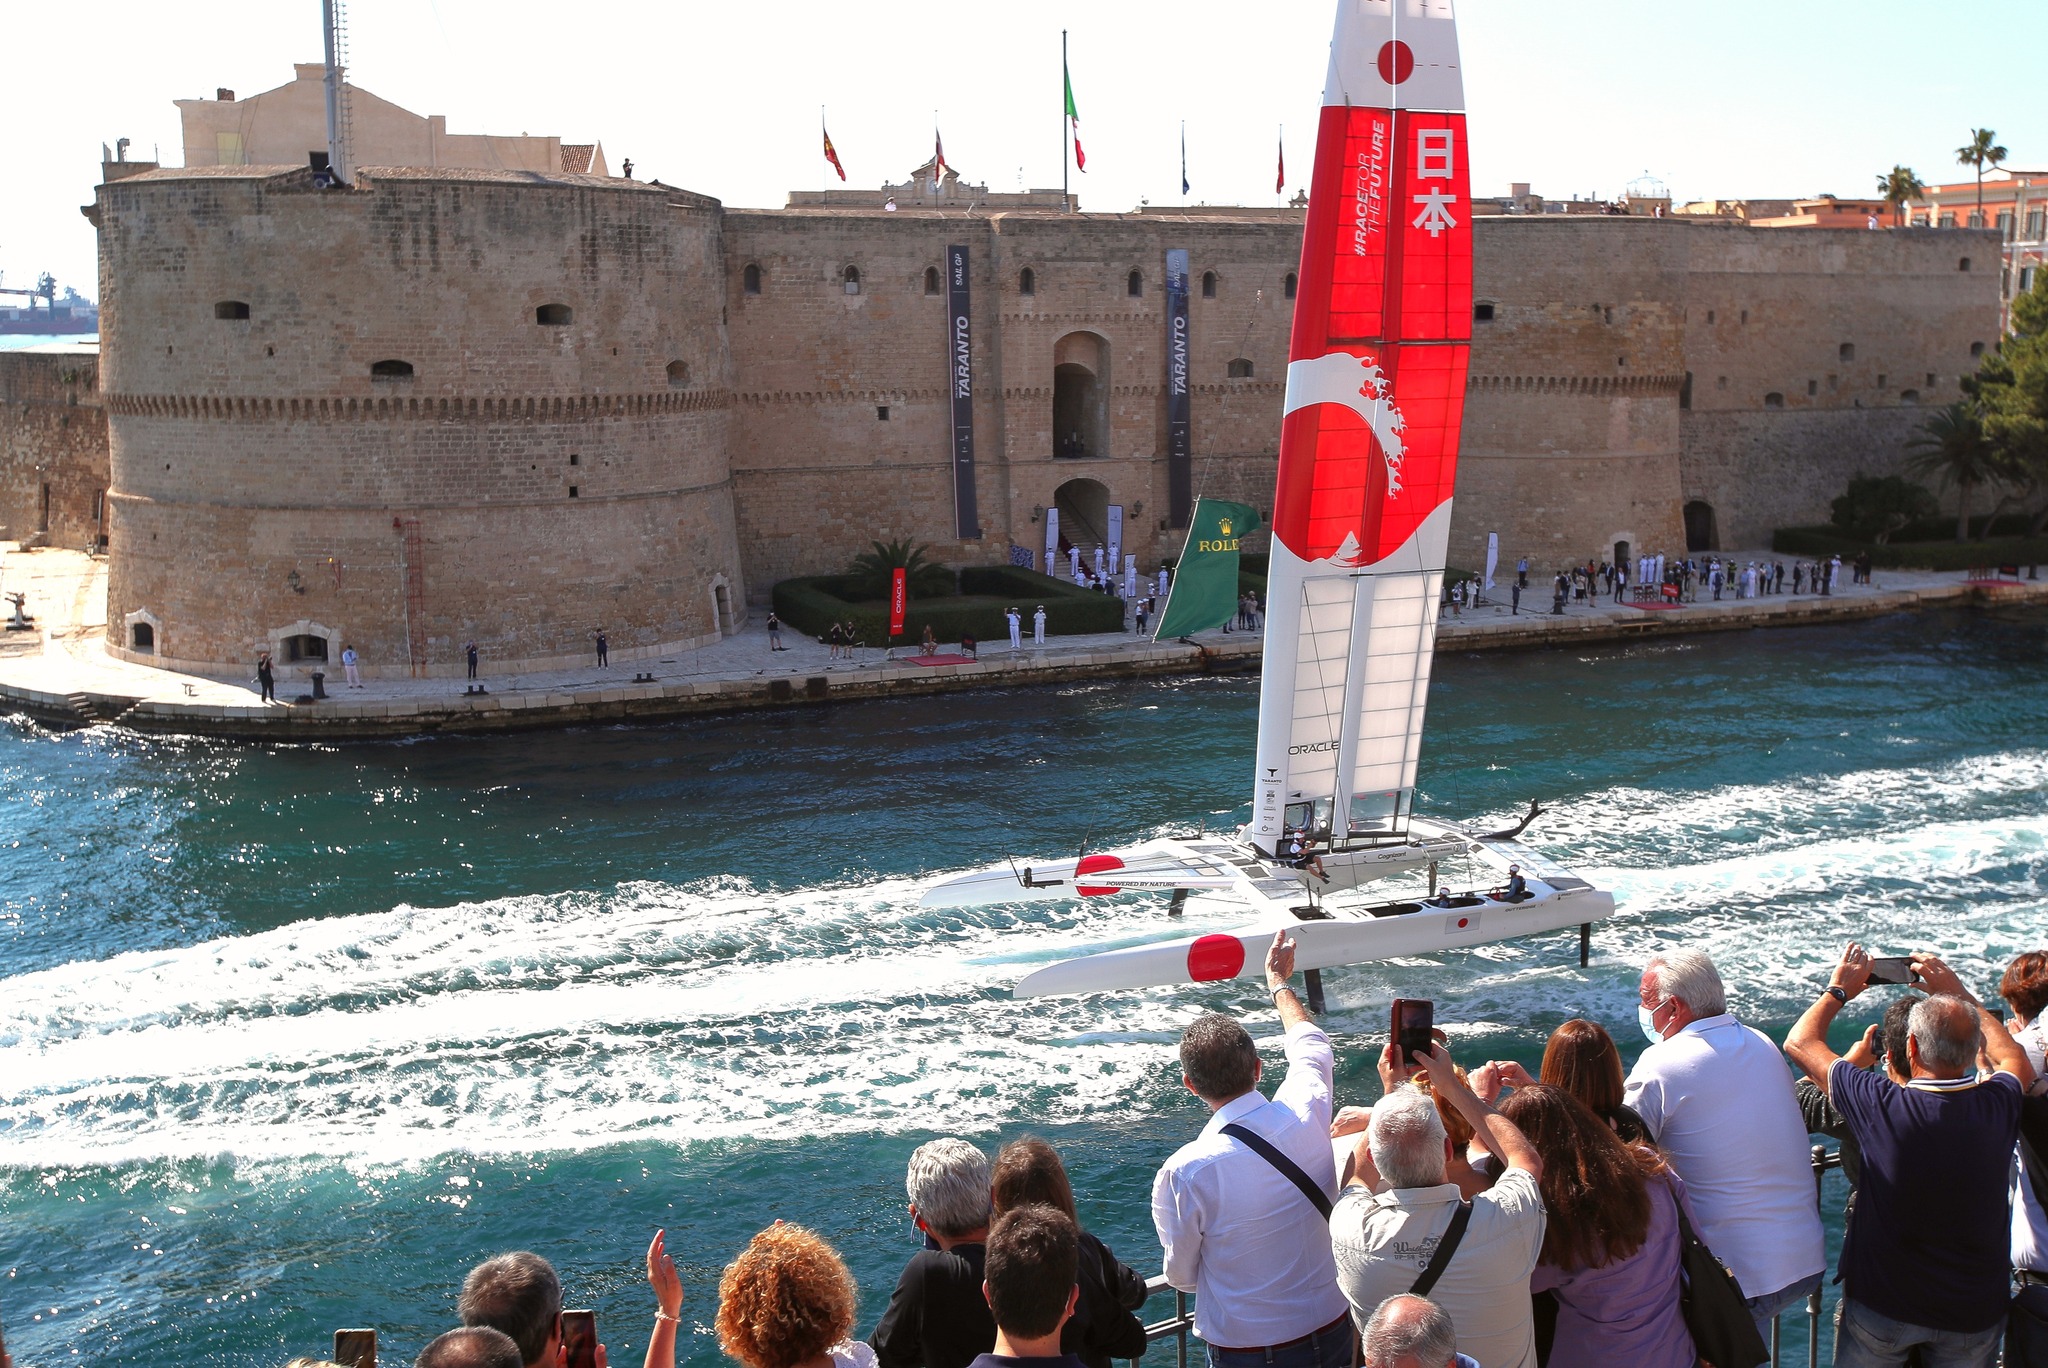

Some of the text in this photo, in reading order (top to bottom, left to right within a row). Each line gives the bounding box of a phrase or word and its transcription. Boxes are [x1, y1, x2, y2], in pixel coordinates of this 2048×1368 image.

[1412, 129, 1457, 237] 日本
[956, 315, 970, 399] TARANTO
[1173, 316, 1187, 396] TARANTO
[1199, 538, 1240, 552] ROLE
[1288, 741, 1339, 756] ORACLE
[1378, 852, 1407, 860] Cognizant
